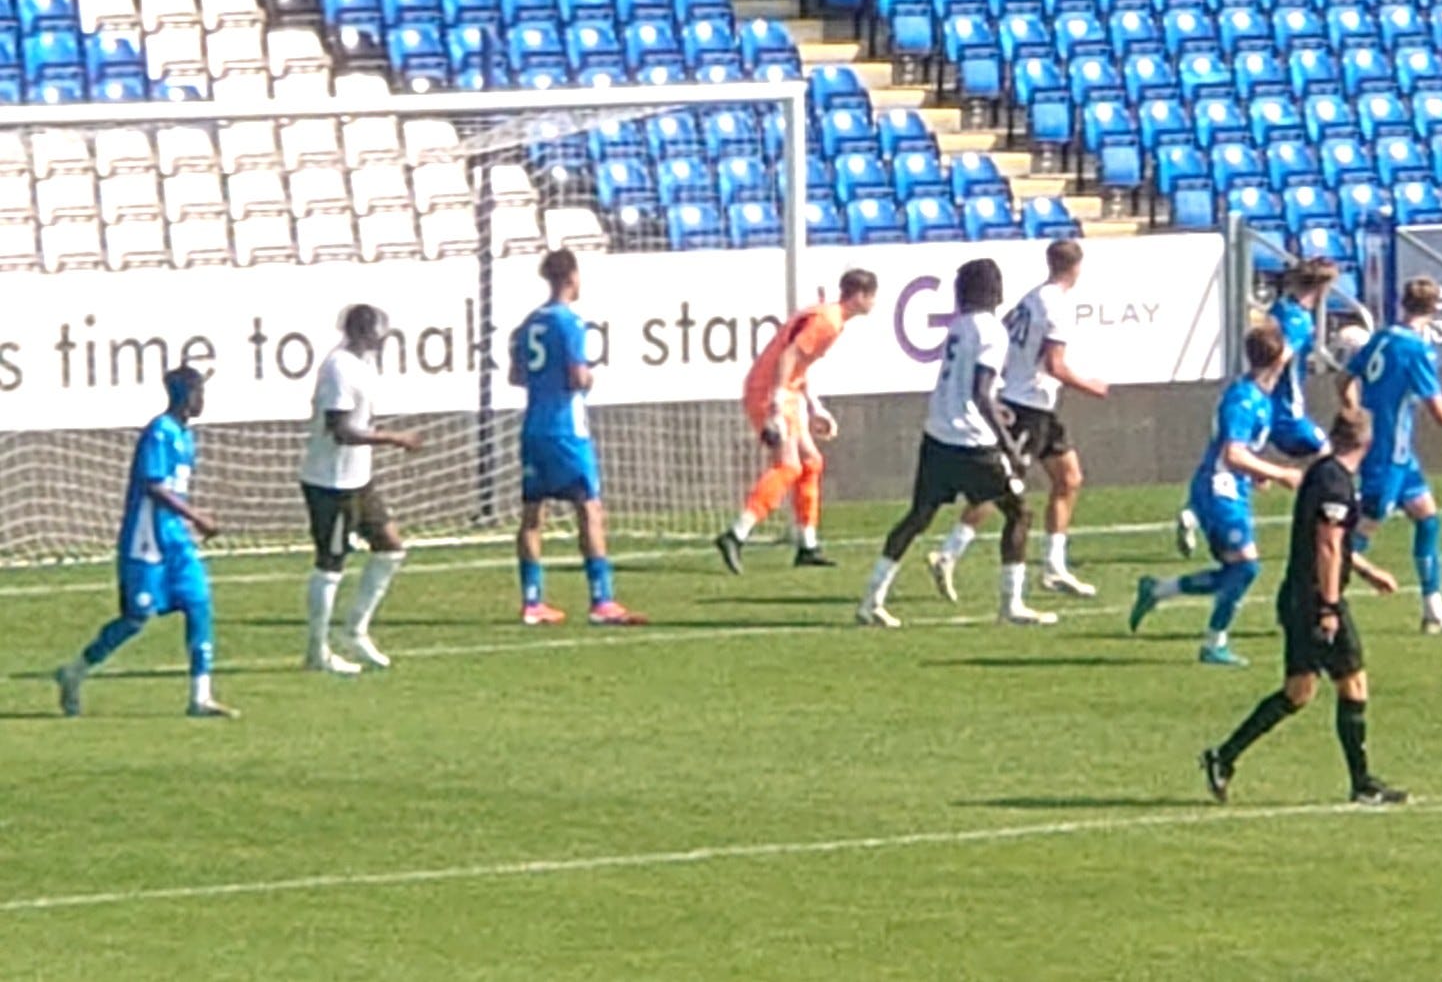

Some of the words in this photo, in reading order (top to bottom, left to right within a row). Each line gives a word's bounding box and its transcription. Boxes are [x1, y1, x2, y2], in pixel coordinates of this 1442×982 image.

[54, 315, 216, 388] time
[248, 316, 314, 380] to
[641, 286, 825, 366] stan
[528, 324, 547, 371] 5
[1366, 337, 1389, 384] 6
